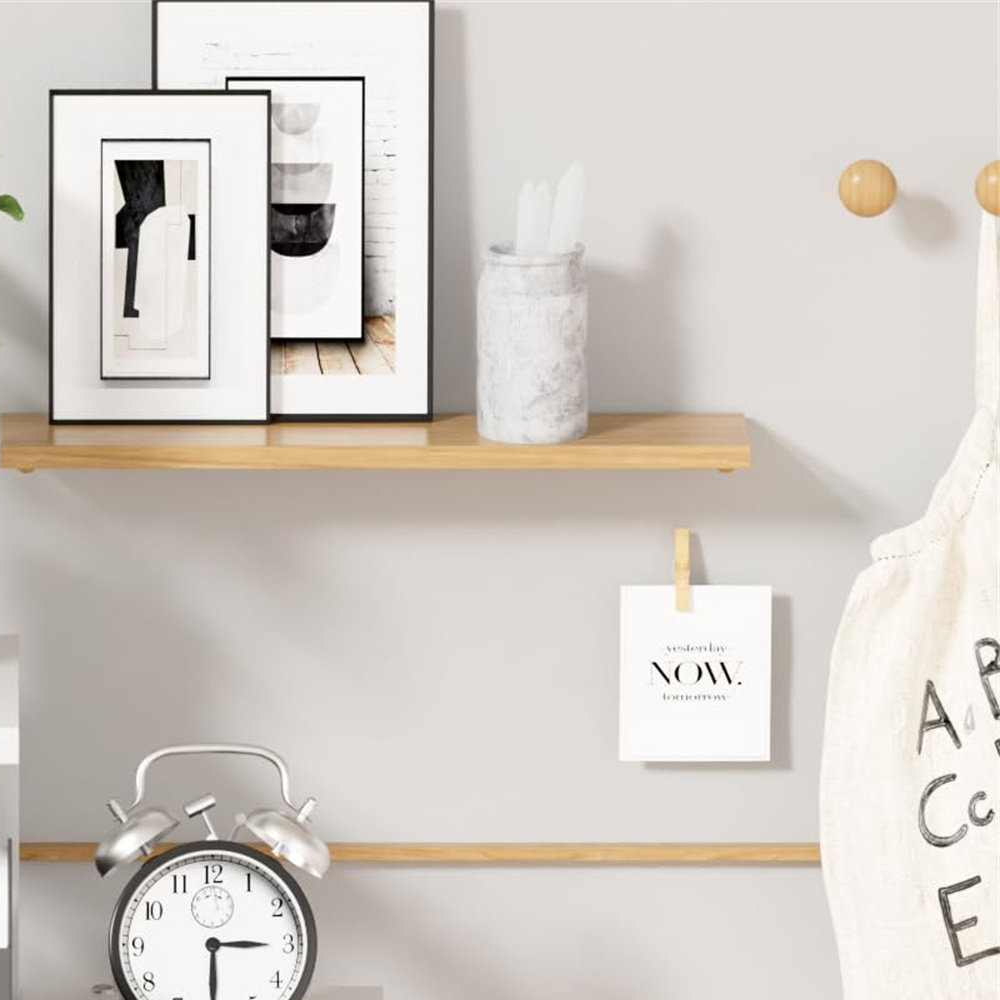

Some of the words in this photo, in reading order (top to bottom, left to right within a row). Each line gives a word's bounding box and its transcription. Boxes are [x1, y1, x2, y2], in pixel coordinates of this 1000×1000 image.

[664, 641, 727, 656] yesterday
[650, 661, 745, 686] NOW.
[662, 692, 728, 701] tomorrow
[204, 864, 223, 884] 12
[246, 872, 251, 892] 1
[172, 875, 187, 894] 11
[145, 901, 163, 921] 10
[271, 898, 284, 917] 2
[132, 937, 144, 957] 9
[282, 934, 295, 954] 3
[143, 972, 155, 992] 8
[269, 970, 283, 989] 4
